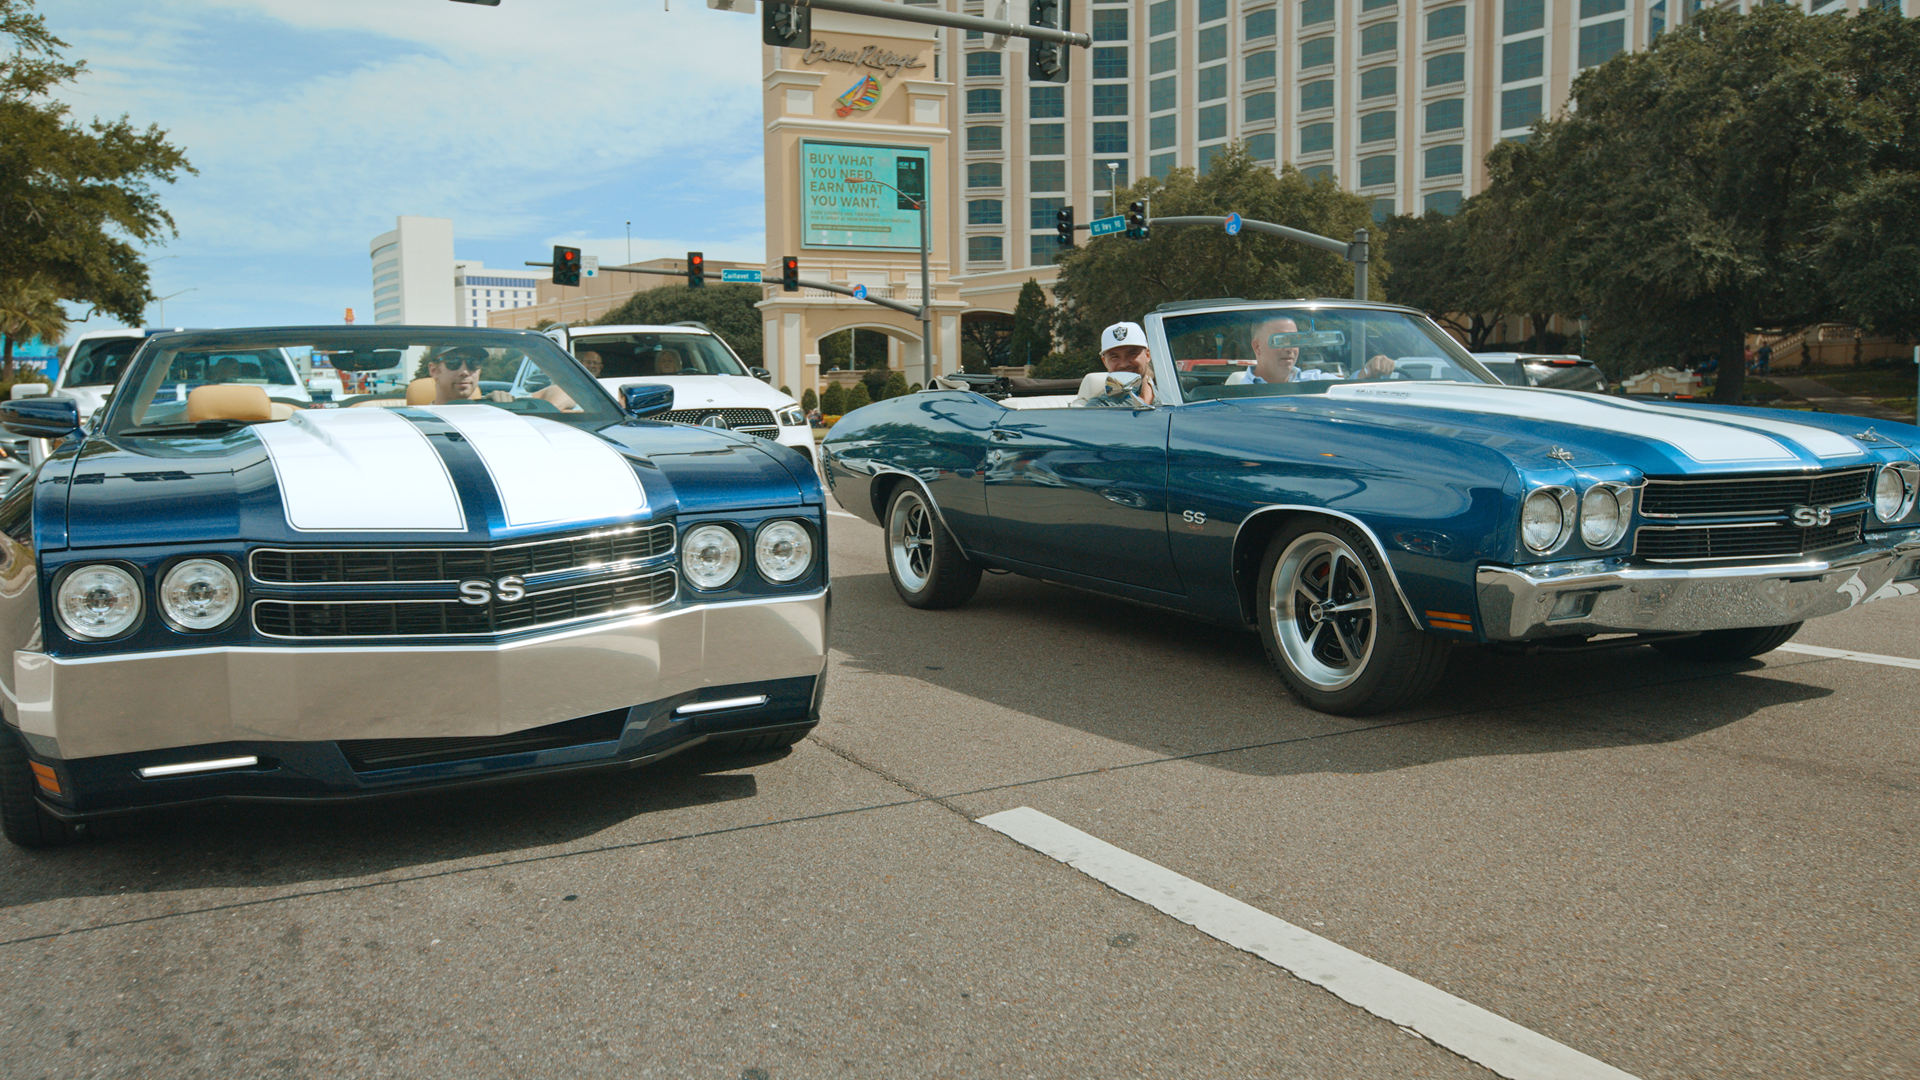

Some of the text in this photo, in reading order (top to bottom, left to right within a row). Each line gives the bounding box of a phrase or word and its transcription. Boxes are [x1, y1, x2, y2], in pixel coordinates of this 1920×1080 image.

[803, 39, 926, 78] Beau Rivage
[810, 153, 874, 167] BUY WHAT
[811, 167, 876, 181] YOU NEED.
[810, 181, 884, 195] EARN WHAT
[811, 195, 880, 209] YOU WANT.
[1094, 219, 1121, 232] US Hwy 90
[723, 272, 750, 280] Caillavet
[1183, 510, 1207, 525] SS
[1793, 504, 1831, 527] SS
[1338, 520, 1378, 570] MICHELIN
[459, 574, 526, 605] SS
